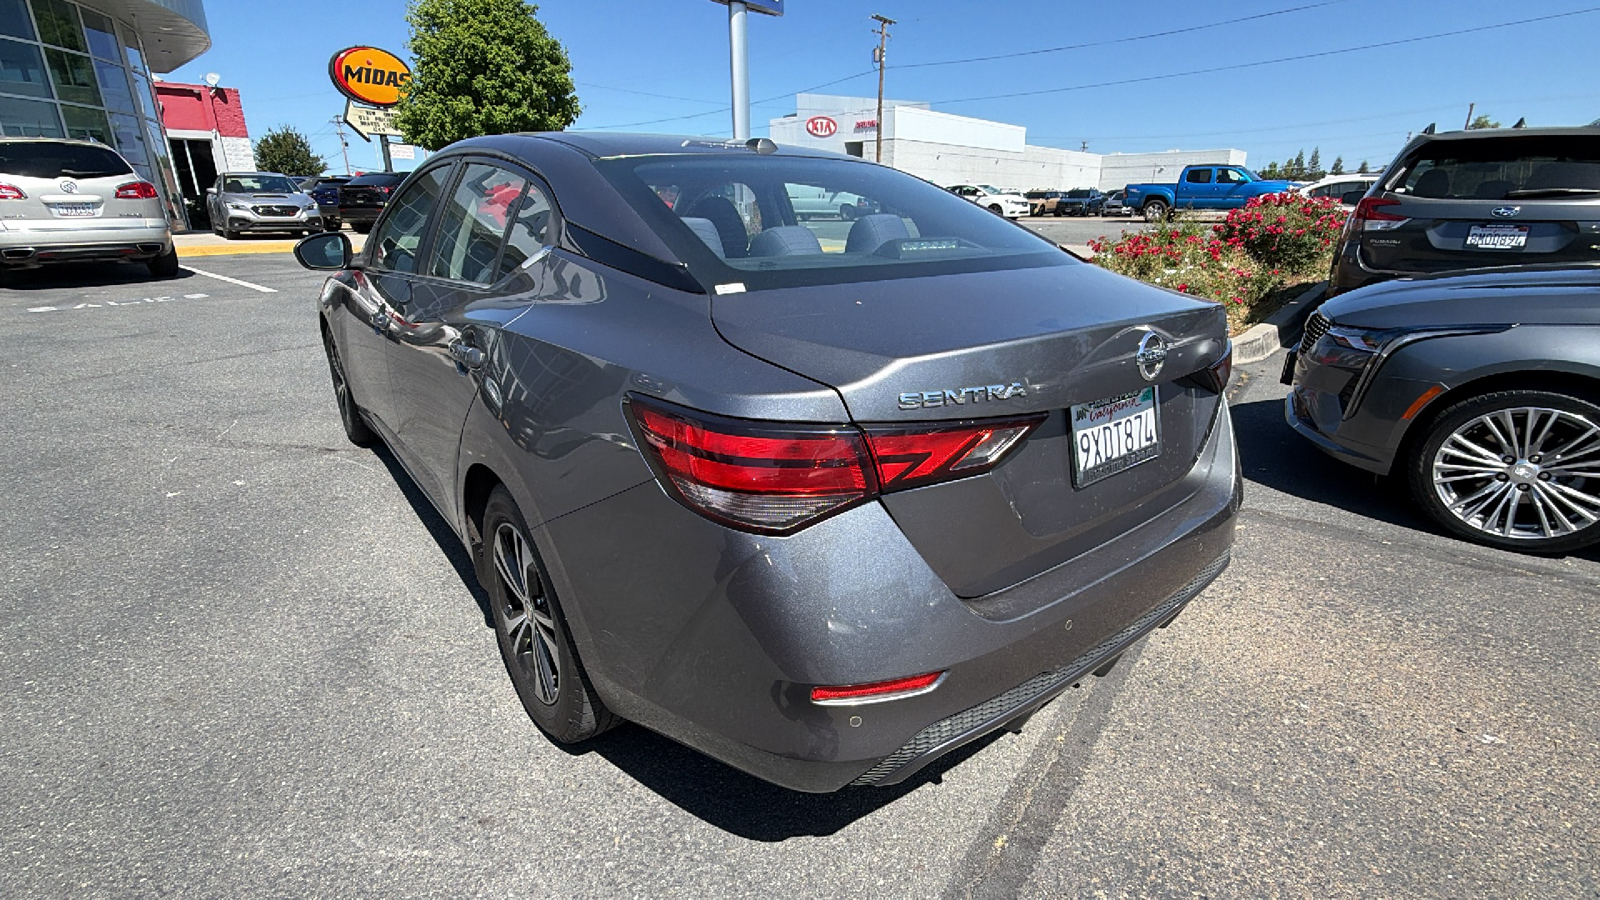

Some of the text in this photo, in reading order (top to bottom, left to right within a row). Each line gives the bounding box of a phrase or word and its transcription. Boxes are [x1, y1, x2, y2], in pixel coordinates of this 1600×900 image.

[898, 382, 1026, 410] SENTRA
[1075, 407, 1087, 422] JAN
[1089, 397, 1141, 422] California
[1080, 411, 1154, 471] 9XDT874
